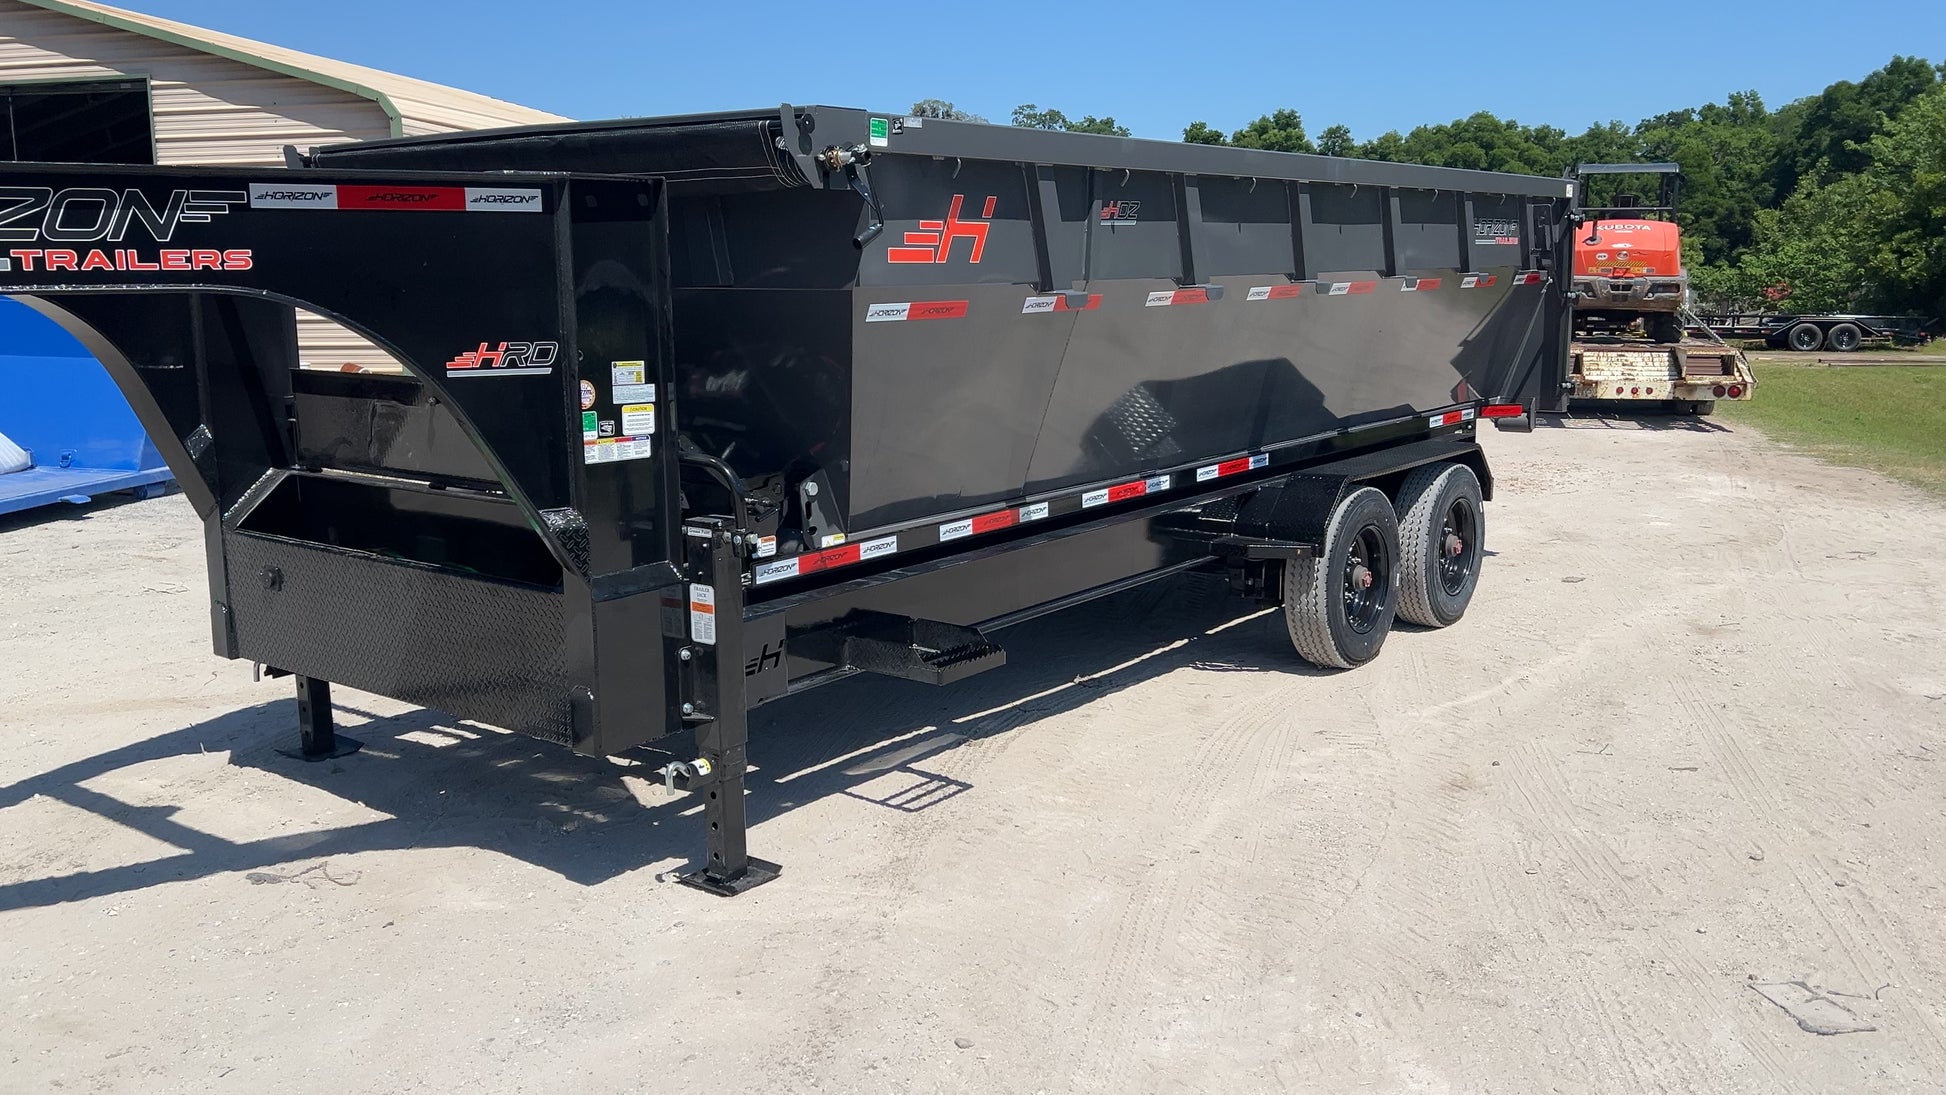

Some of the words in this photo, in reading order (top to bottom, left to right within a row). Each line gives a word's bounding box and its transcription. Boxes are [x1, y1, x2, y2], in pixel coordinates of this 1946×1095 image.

[263, 191, 326, 201] HORIZON
[476, 194, 532, 204] HORIZON
[10, 249, 253, 271] TRAILERS
[472, 341, 559, 367] HRD
[864, 541, 894, 553] HORIZON
[761, 563, 795, 577] HORIZON
